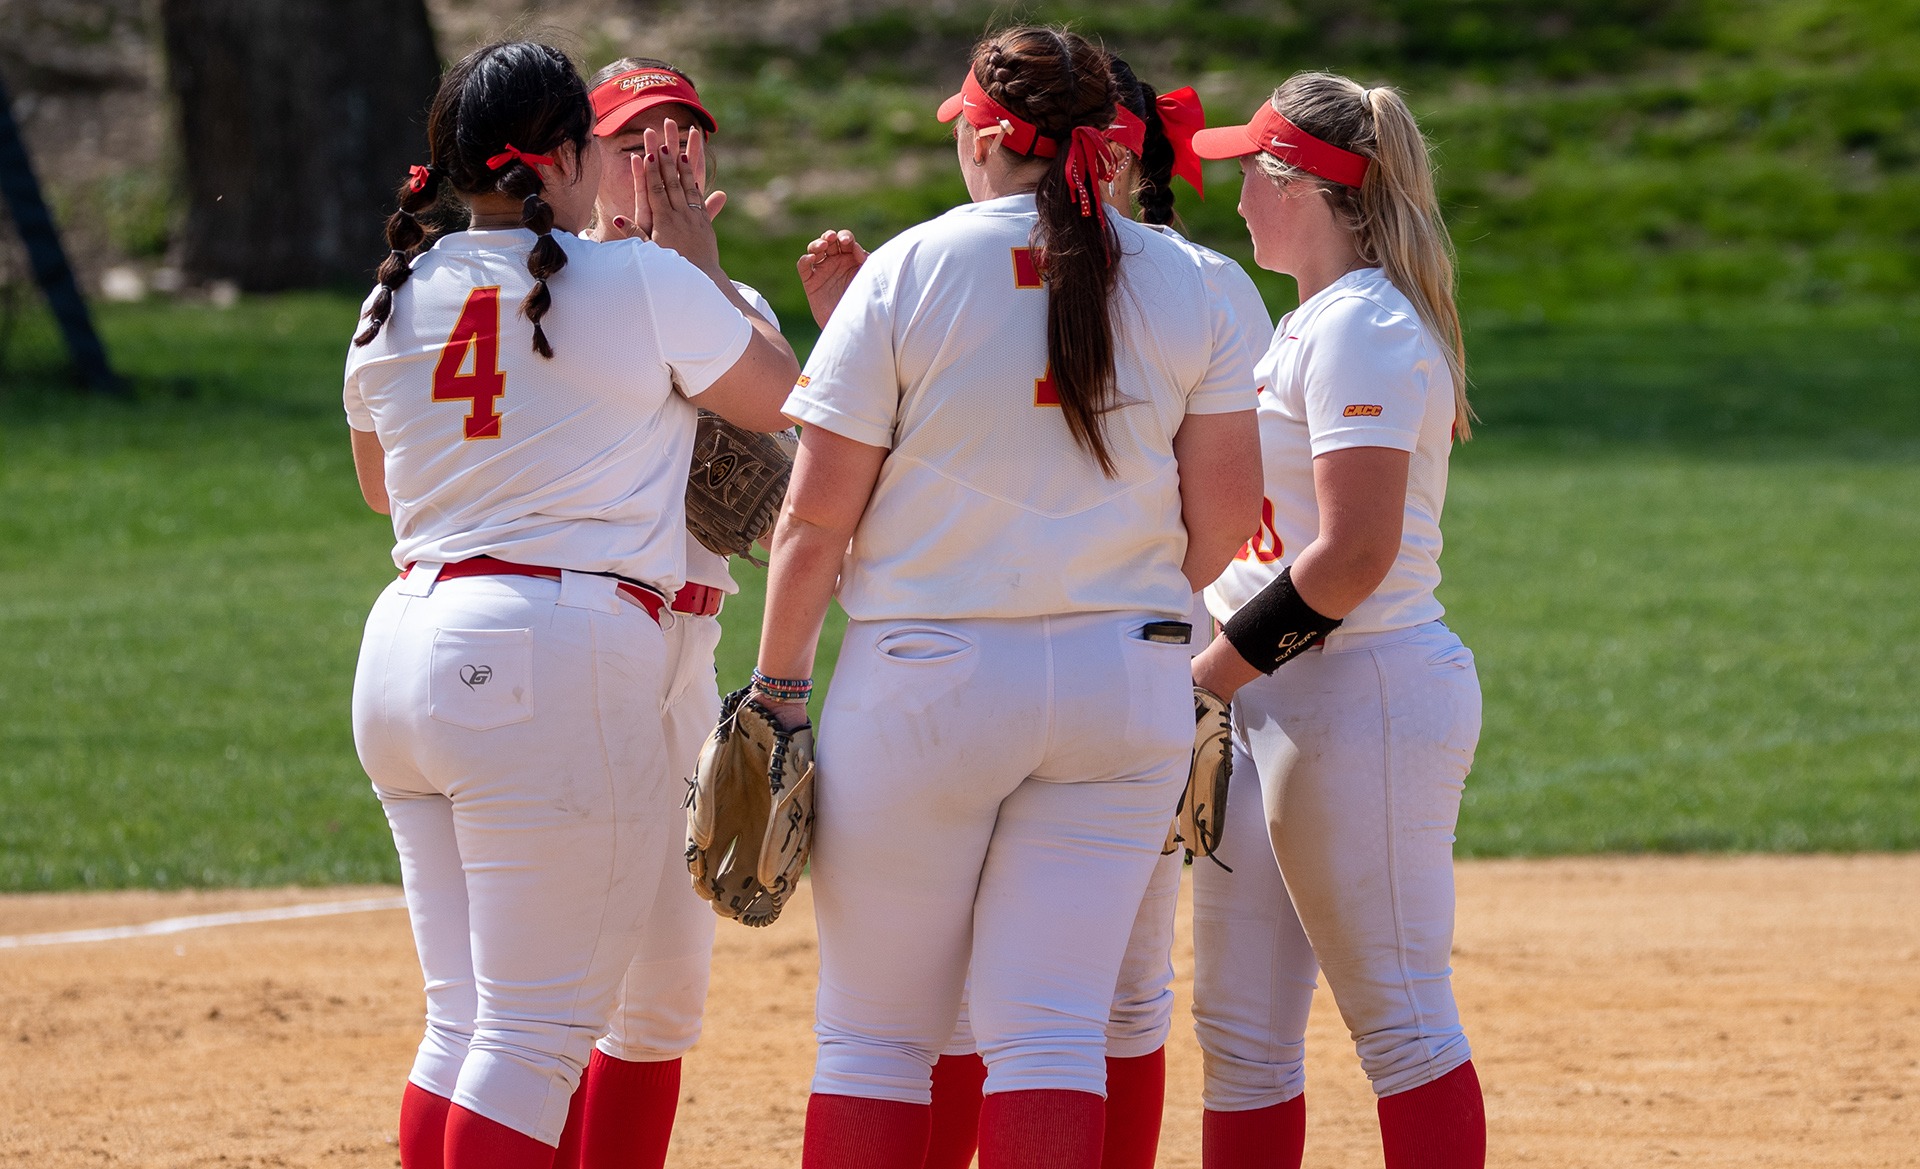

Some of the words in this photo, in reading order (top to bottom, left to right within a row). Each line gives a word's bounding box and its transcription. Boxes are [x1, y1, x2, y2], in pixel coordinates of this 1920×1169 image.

[431, 285, 506, 441] 4
[1343, 404, 1383, 417] CACC
[1233, 496, 1285, 564] 0
[1275, 631, 1317, 662] CUTTERS
